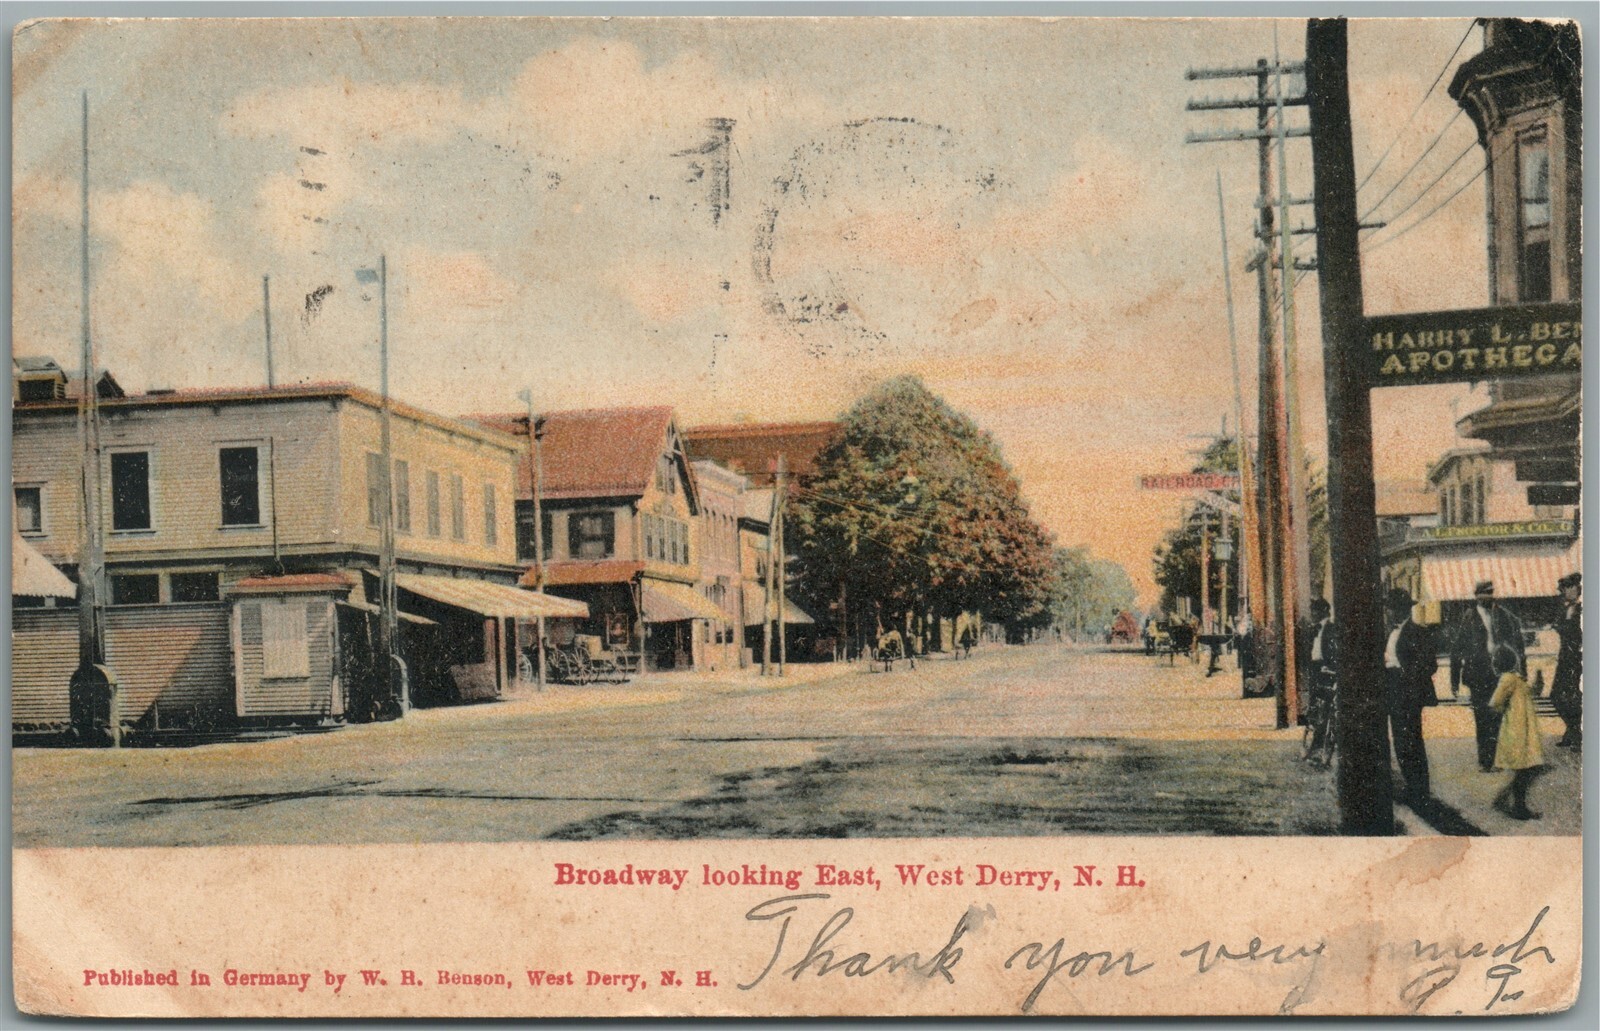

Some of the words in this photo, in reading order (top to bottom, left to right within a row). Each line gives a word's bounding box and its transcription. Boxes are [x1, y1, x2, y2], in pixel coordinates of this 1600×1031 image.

[1372, 328, 1474, 350] HARRY
[1141, 474, 1214, 490] RAILROAD
[738, 893, 969, 990] Thank
[1004, 938, 1155, 1013] you
[1180, 936, 1327, 1014] very
